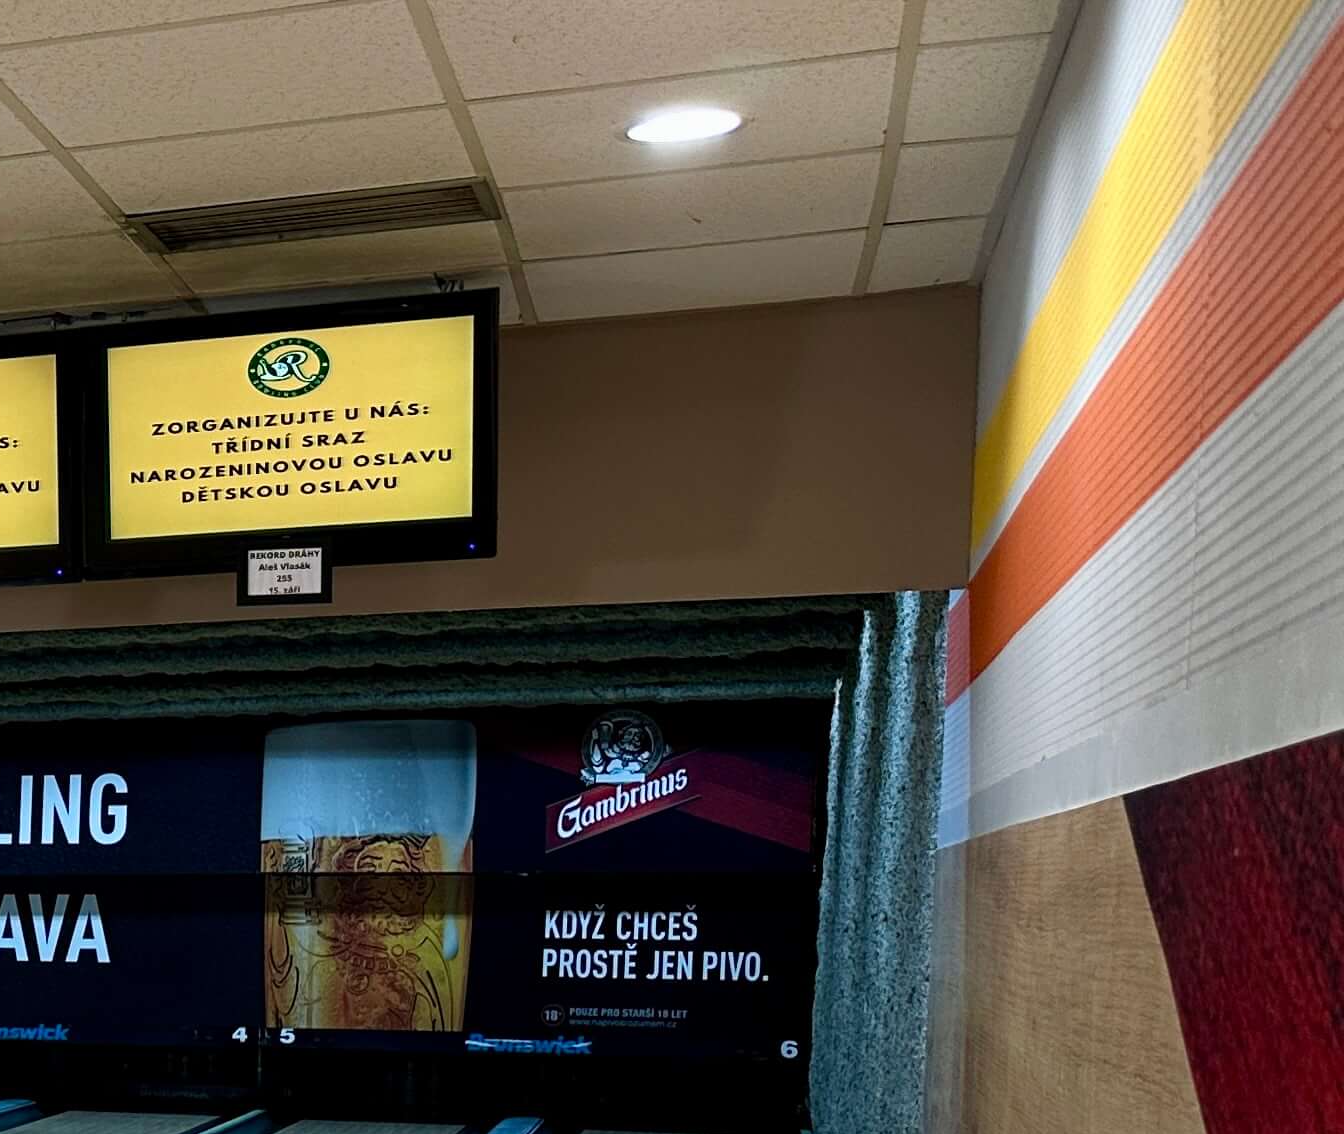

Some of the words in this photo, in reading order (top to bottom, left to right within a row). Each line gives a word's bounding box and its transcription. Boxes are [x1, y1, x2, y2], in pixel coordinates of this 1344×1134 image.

[151, 410, 334, 436] ZORGANIZUJTE
[344, 407, 360, 421] U
[370, 401, 430, 419] NÁS:
[212, 432, 291, 455] TŘÍDNÍ
[301, 430, 366, 447] SRAZ
[130, 456, 343, 483] NAROZENINOVOU
[353, 448, 453, 468] OSLAVU
[181, 483, 289, 504] DĚTSKOU
[300, 476, 398, 496] OSLAVU
[250, 551, 286, 559] REKORD
[557, 768, 688, 839] Gambrinus
[544, 903, 605, 940] KDYŽ
[616, 904, 698, 941] CHCEŠ
[542, 942, 637, 979] PROSTĚ
[645, 950, 693, 980] JEN
[702, 951, 769, 982] PIVO.
[569, 1007, 598, 1017] POUZE
[601, 1008, 620, 1017] PRO
[657, 1010, 669, 1018] 18
[671, 1010, 688, 1019] LET
[231, 1026, 248, 1043] 4
[279, 1027, 296, 1044] 5
[780, 1040, 799, 1059] 6
